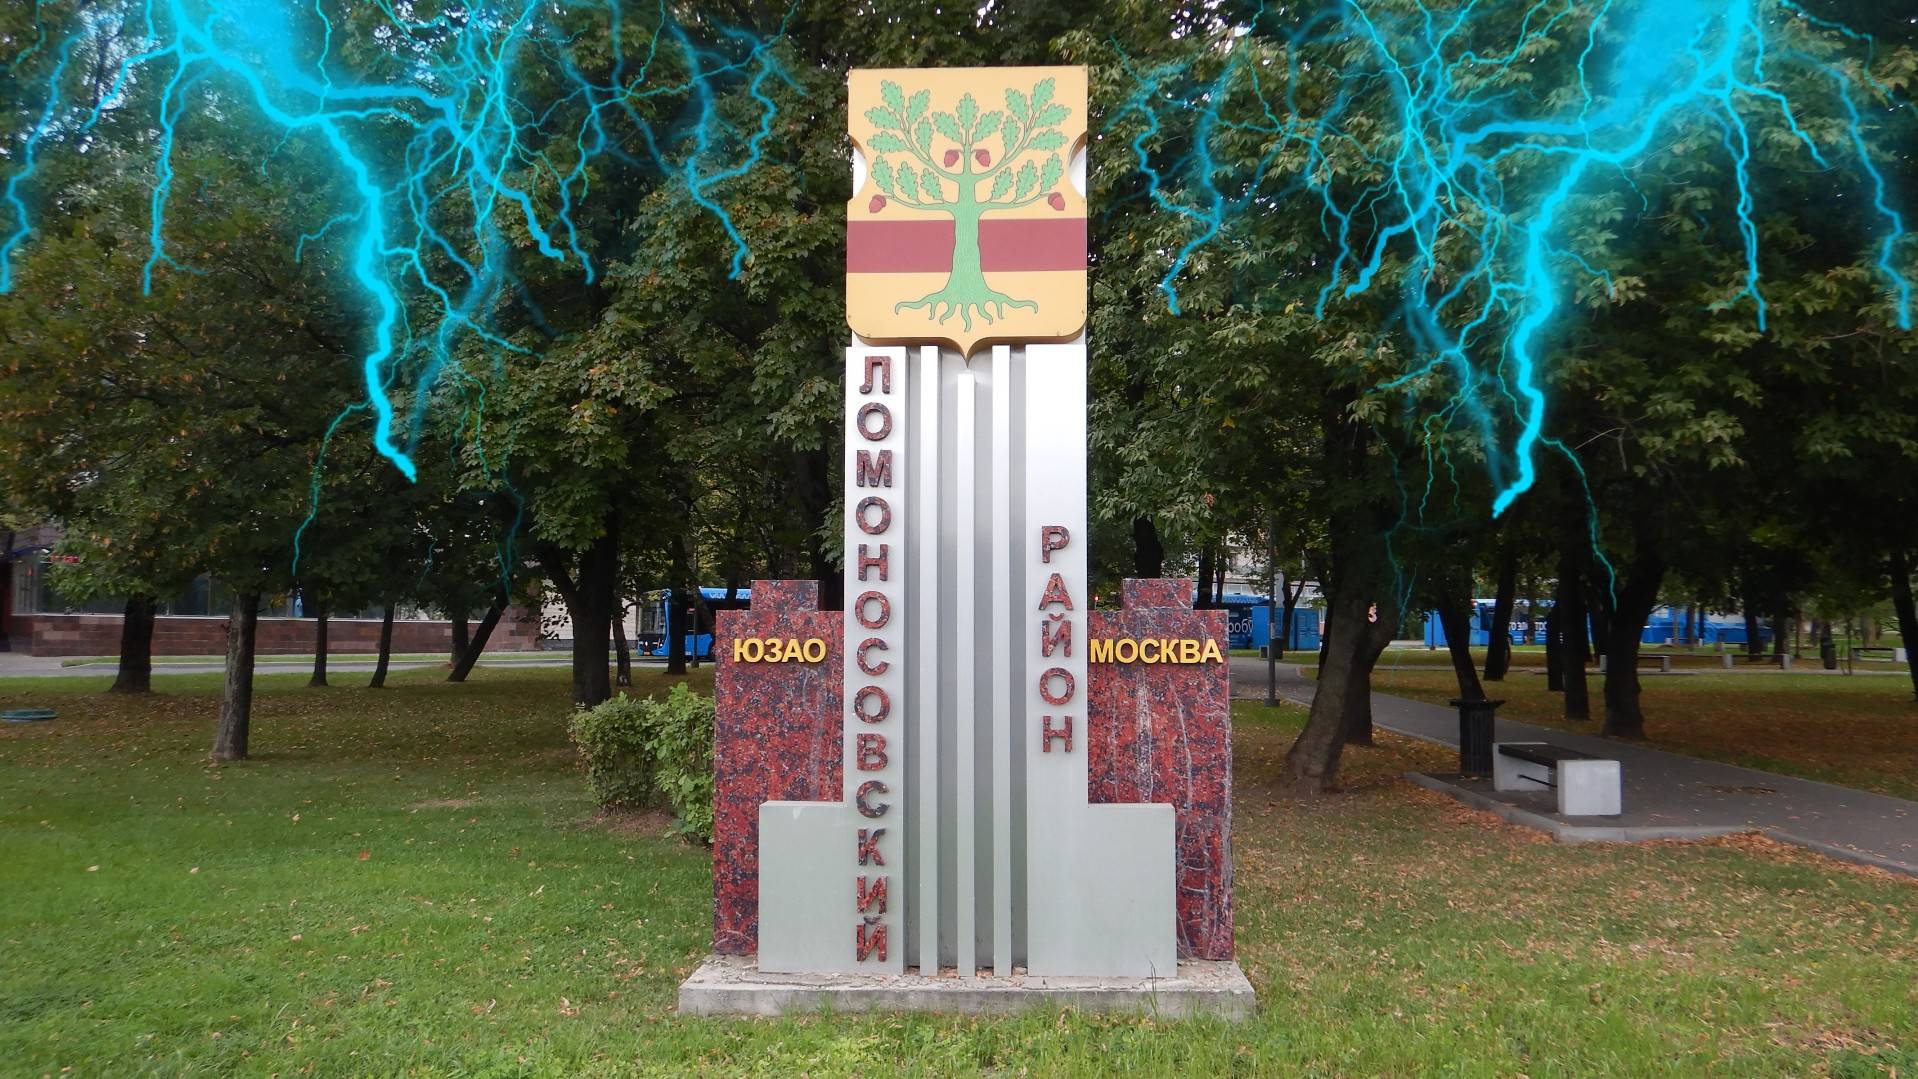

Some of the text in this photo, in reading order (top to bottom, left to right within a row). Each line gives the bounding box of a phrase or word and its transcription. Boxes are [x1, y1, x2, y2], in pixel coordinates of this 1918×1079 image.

[733, 638, 827, 663] ЮЗАО
[855, 356, 892, 962] ЛОМОНОСОВСКИЙ
[1039, 525, 1075, 753] РАЙОН
[1090, 638, 1224, 664] МОСКВА
